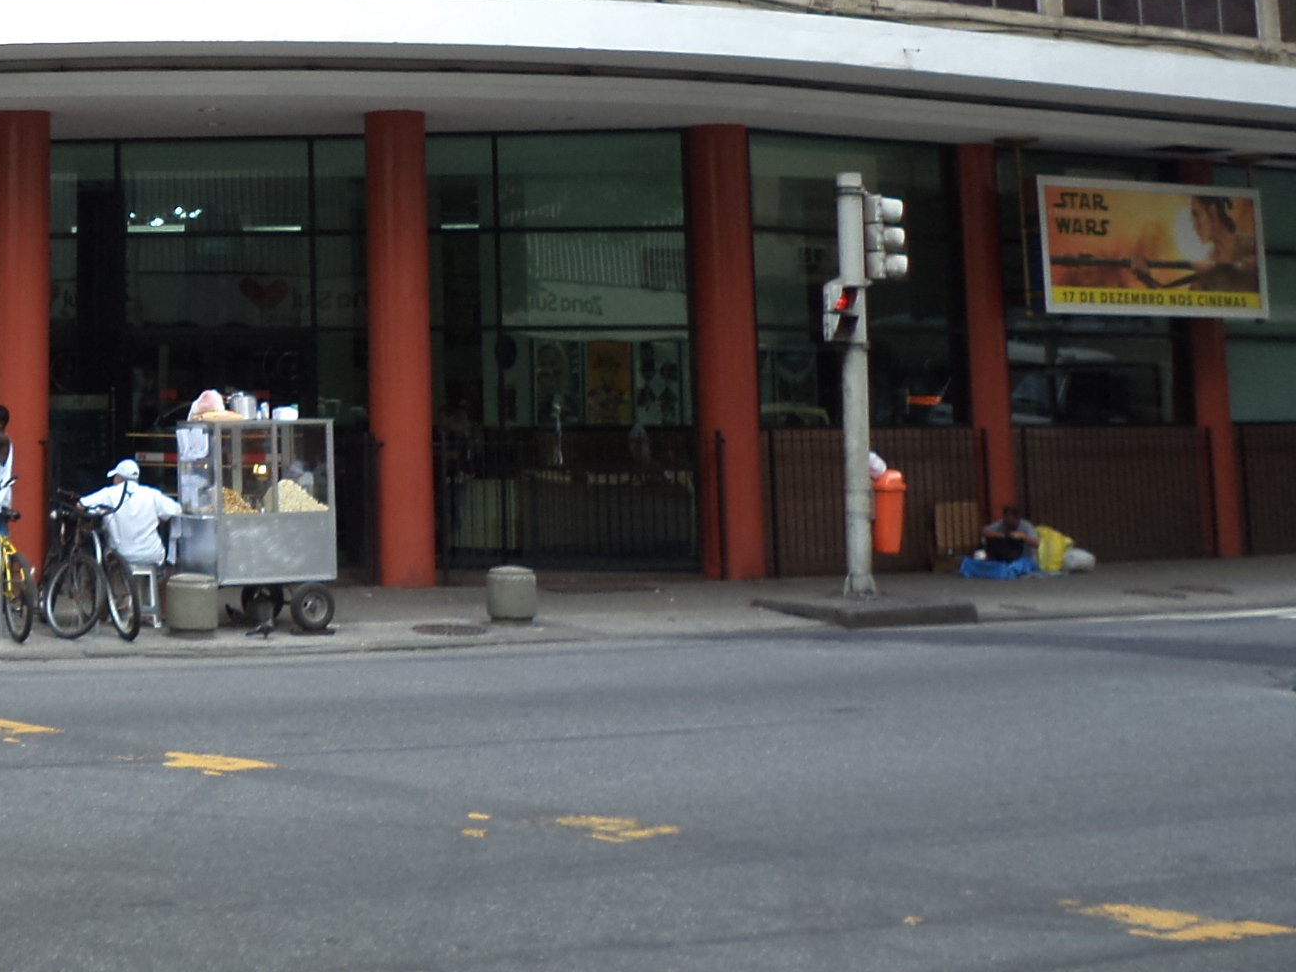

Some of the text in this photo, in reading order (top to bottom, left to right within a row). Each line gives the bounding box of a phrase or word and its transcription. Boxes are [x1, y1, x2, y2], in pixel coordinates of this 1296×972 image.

[1053, 192, 1109, 211] STAR
[1055, 217, 1110, 236] WARS
[1062, 291, 1247, 308] 17 DE DEZEMBRO NOS CINEMAS
